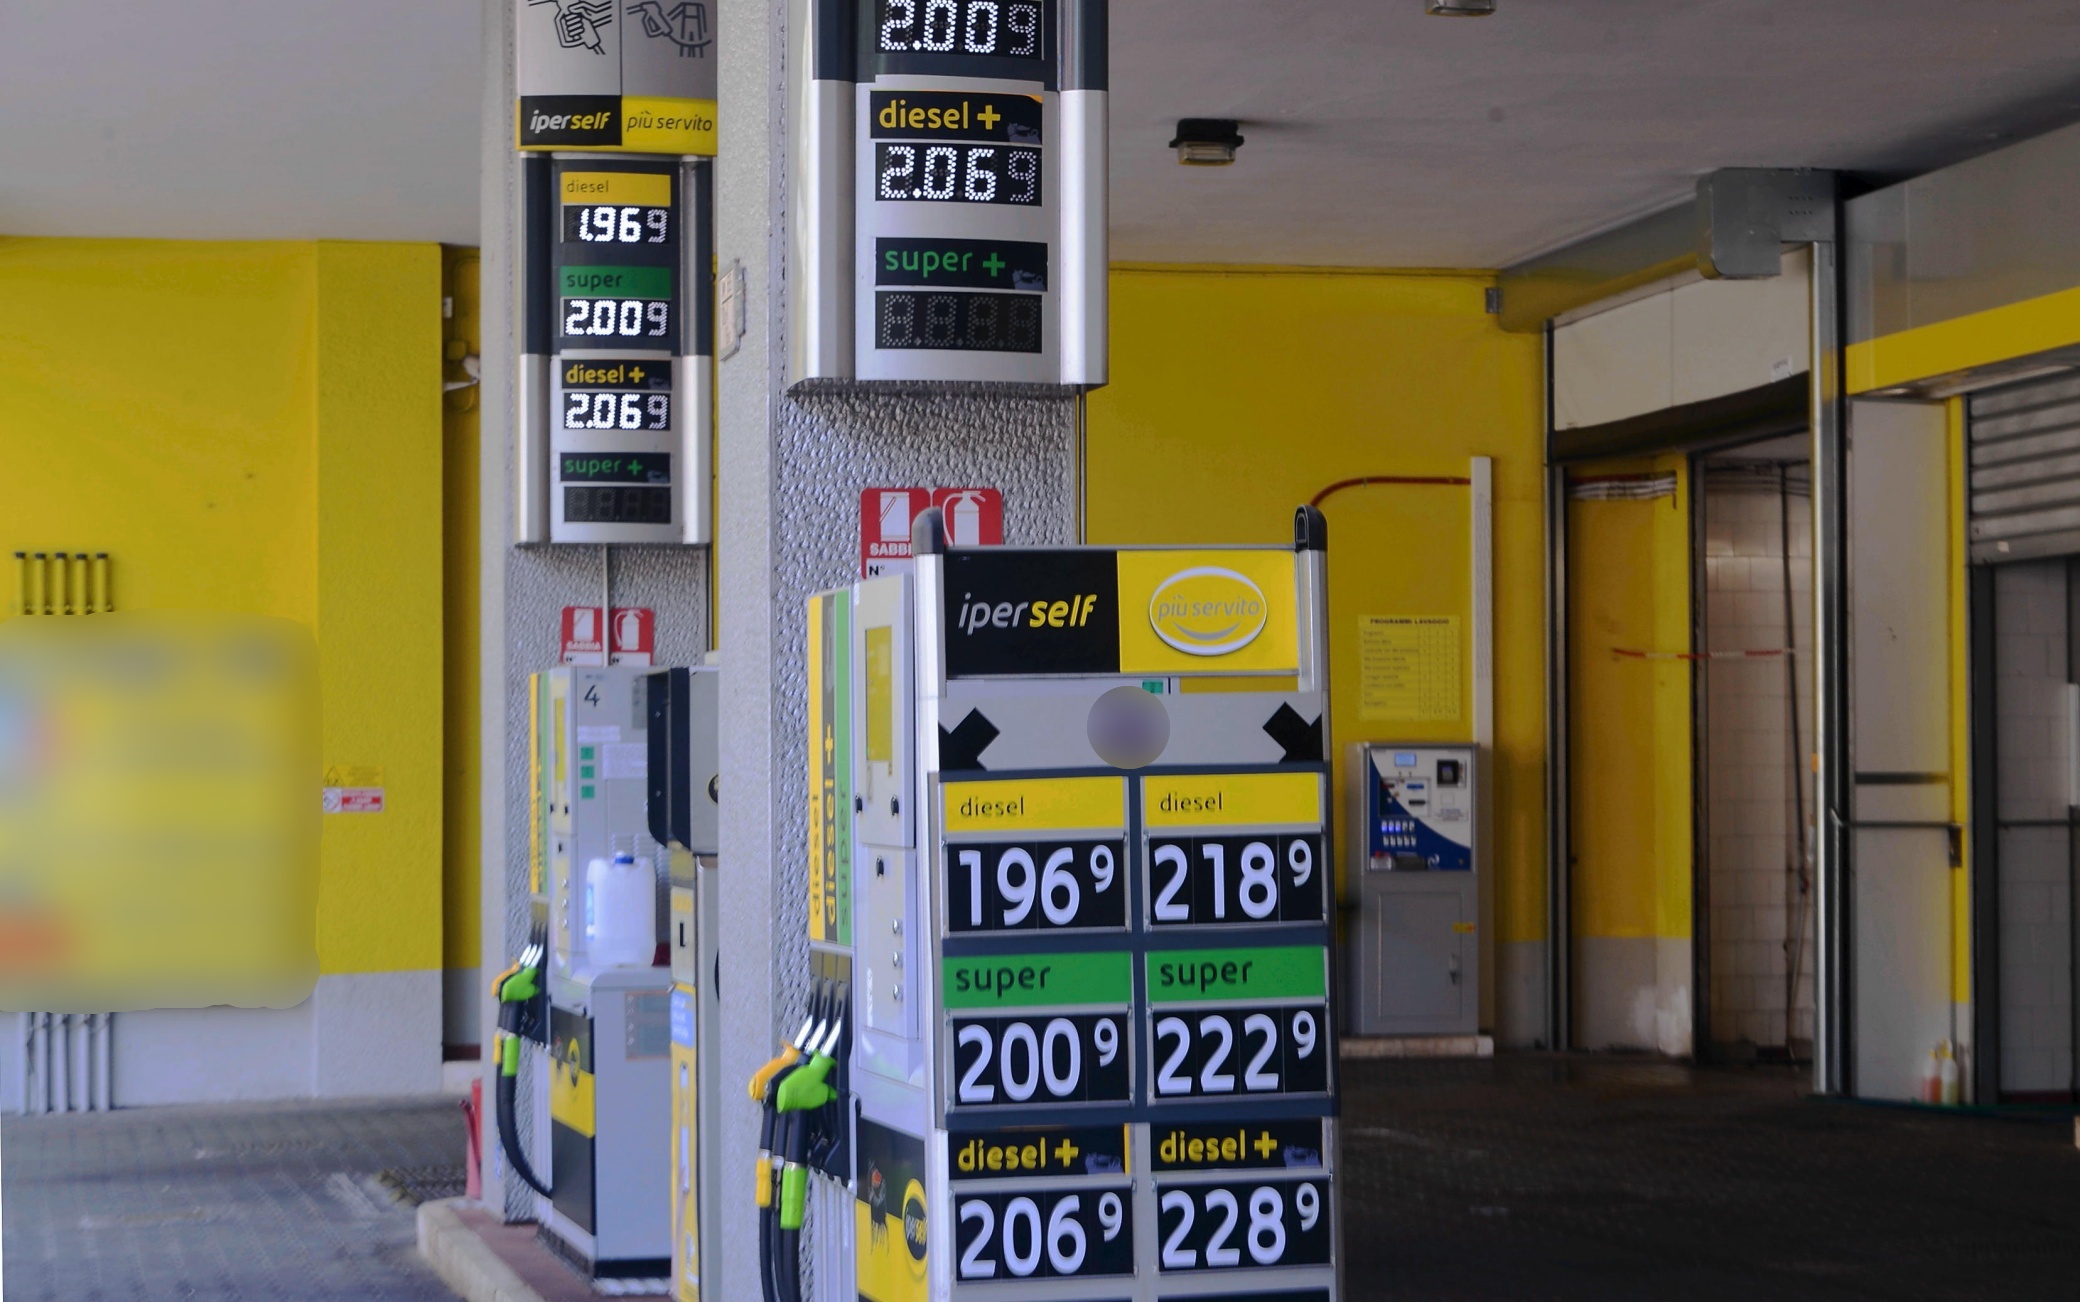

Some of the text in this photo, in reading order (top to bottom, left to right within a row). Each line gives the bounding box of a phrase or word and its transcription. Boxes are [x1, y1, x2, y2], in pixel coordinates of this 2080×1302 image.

[880, 0, 1037, 55] 2.009
[529, 109, 611, 134] iperself
[626, 110, 713, 132] più servito
[879, 99, 969, 130] diesel
[566, 180, 609, 193] diesel
[880, 146, 1037, 202] 2.069
[578, 206, 668, 243] 1.969
[885, 250, 973, 278] super
[566, 274, 624, 292] super
[565, 299, 668, 336] 2.009
[565, 364, 625, 384] diesel
[565, 393, 668, 430] 2.069
[564, 459, 621, 477] super
[869, 542, 912, 556] SABBI
[958, 592, 1098, 635] iperself
[1157, 594, 1260, 623] più servito
[584, 684, 600, 708] 4
[960, 796, 1025, 818] diesel
[1159, 791, 1223, 813] diesel
[812, 794, 821, 919] diesel
[824, 778, 836, 925] diesel
[840, 784, 849, 927] super
[955, 965, 1051, 998] super
[1160, 959, 1253, 993] super
[958, 1136, 1046, 1172] diesel
[1159, 1128, 1246, 1164] diesel
